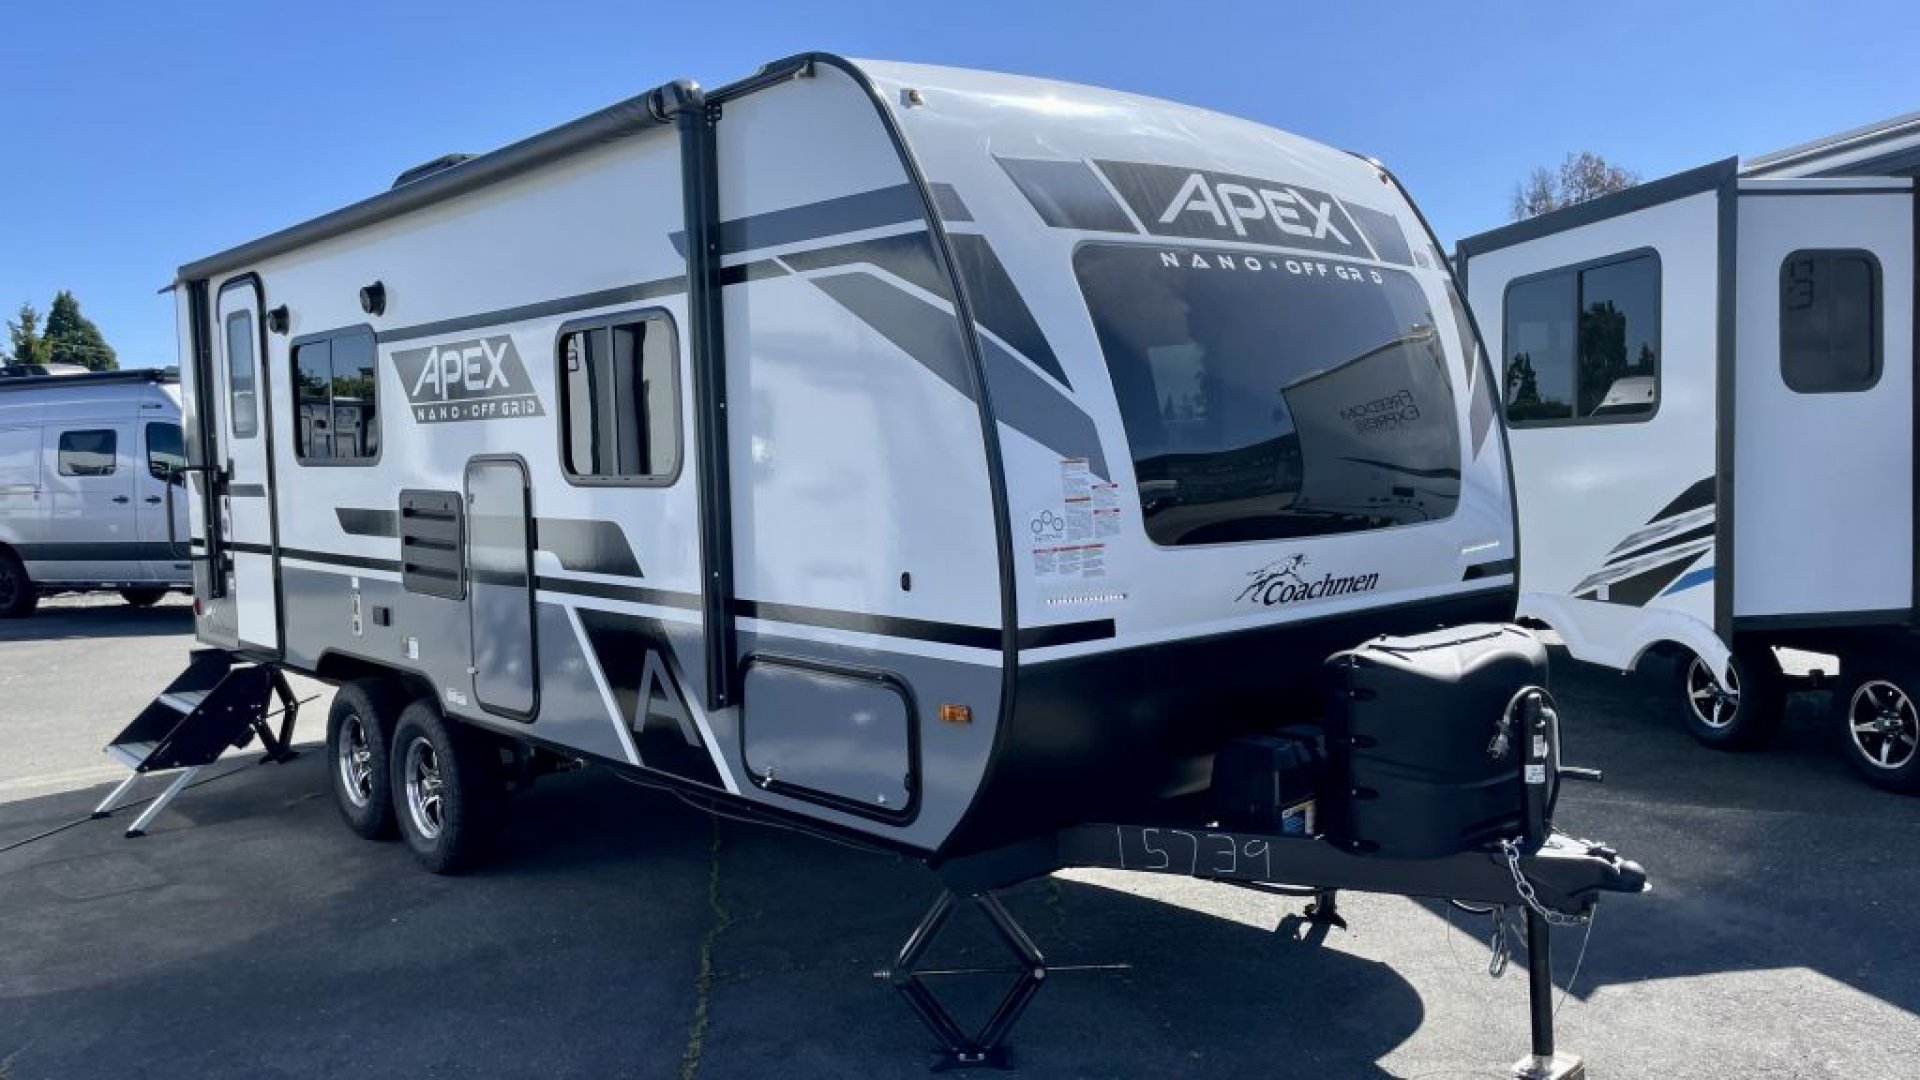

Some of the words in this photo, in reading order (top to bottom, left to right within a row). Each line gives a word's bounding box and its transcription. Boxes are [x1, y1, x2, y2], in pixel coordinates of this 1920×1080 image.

[1158, 173, 1351, 245] APEX
[1160, 252, 1262, 271] NANO
[1286, 259, 1327, 277] OFF
[1335, 265, 1383, 284] GRD
[411, 339, 510, 401] APEX
[417, 405, 460, 420] NANO
[471, 402, 496, 417] OFF
[501, 399, 535, 416] GRID
[1263, 572, 1380, 606] Coachmen
[1117, 826, 1271, 879] 15739
